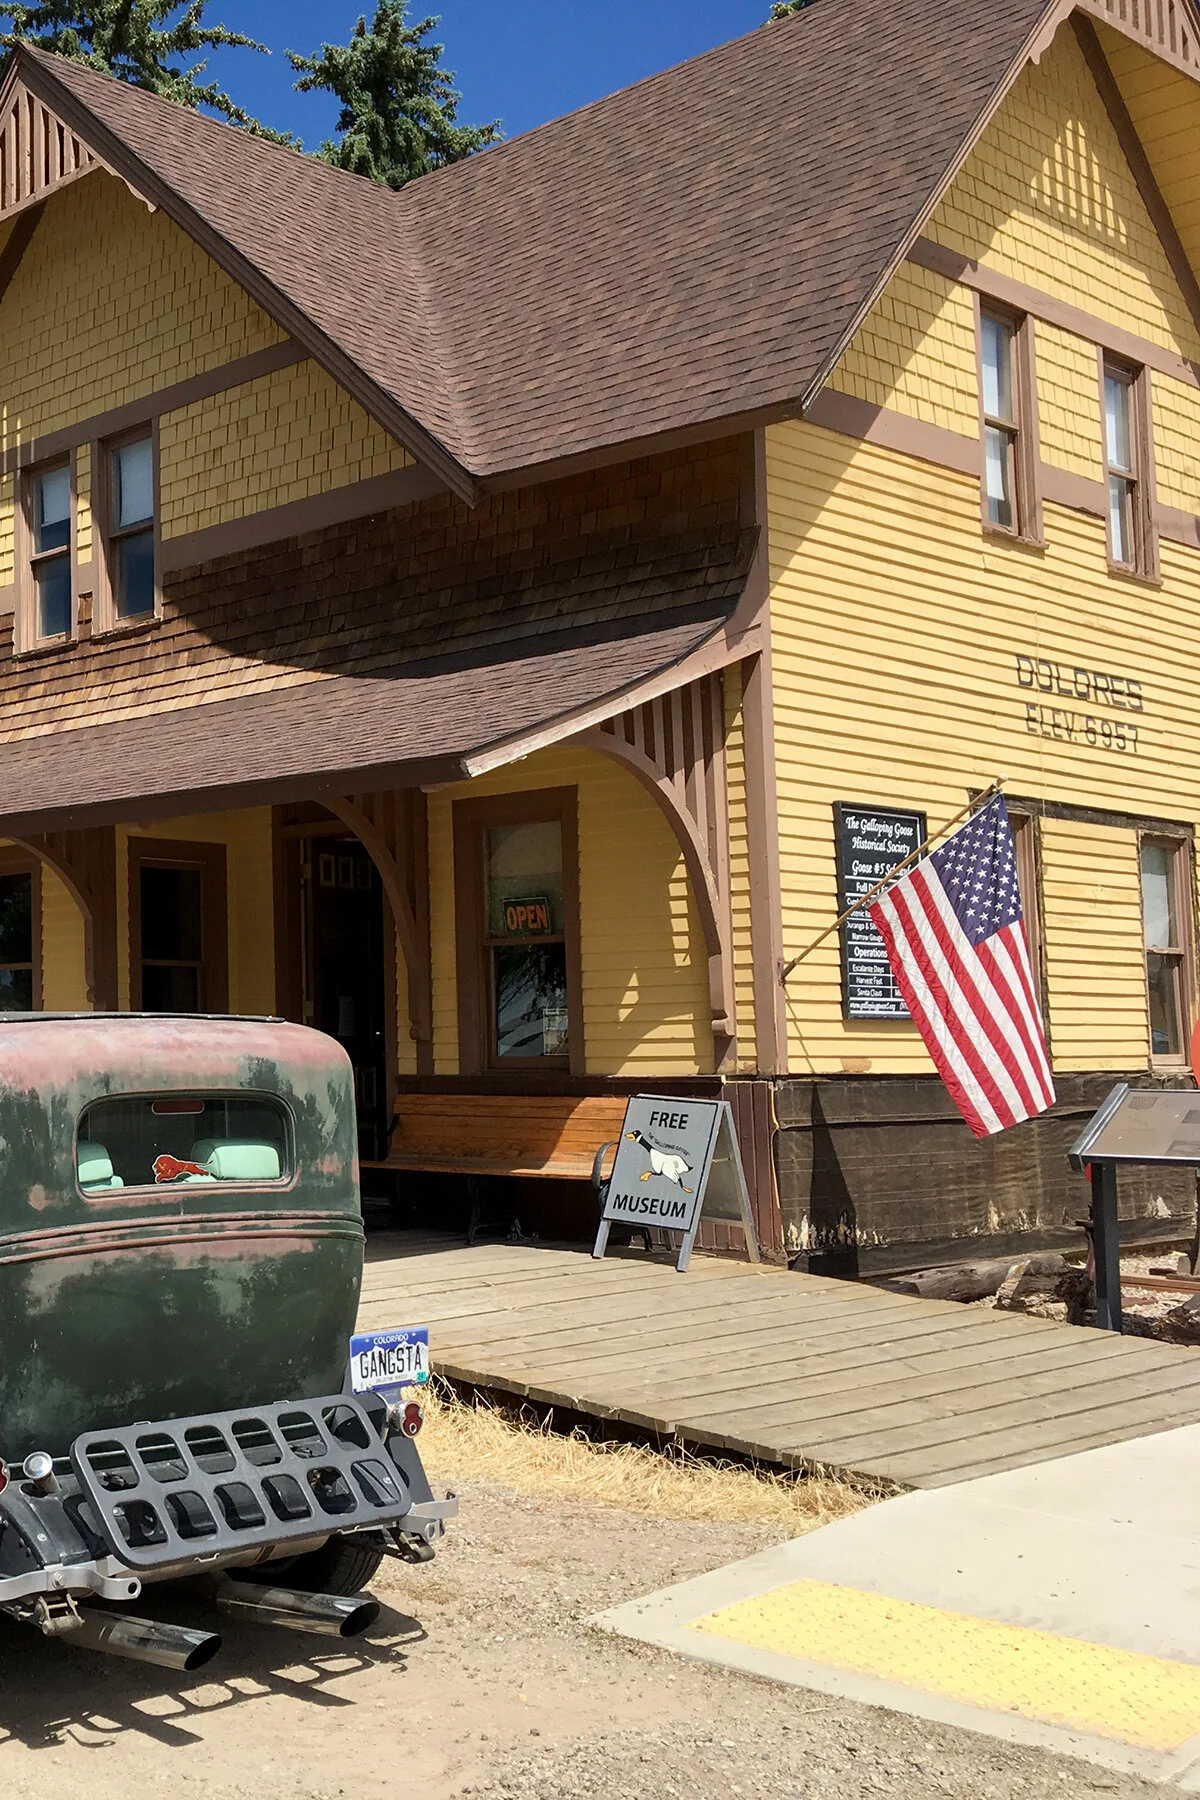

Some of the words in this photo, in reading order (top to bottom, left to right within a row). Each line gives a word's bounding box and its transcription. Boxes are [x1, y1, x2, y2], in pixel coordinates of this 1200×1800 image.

[1016, 654, 1143, 712] DOLORES
[1026, 703, 1077, 742] ELEV.
[1086, 716, 1138, 753] 6957
[845, 816, 859, 829] The
[861, 819, 893, 837] Galloping
[894, 823, 913, 838] Goose
[851, 836, 887, 851] Historical
[887, 840, 910, 857] Society
[852, 860, 872, 876] Goose
[874, 863, 885, 875] #5
[856, 881, 867, 892] Full
[506, 905, 549, 931] OPEN
[853, 946, 888, 959] Operations
[649, 1111, 688, 1130] FREE
[613, 1194, 686, 1218] MUSEUM
[373, 1333, 409, 1345] COLORADO
[360, 1345, 422, 1379] GANGSTA
